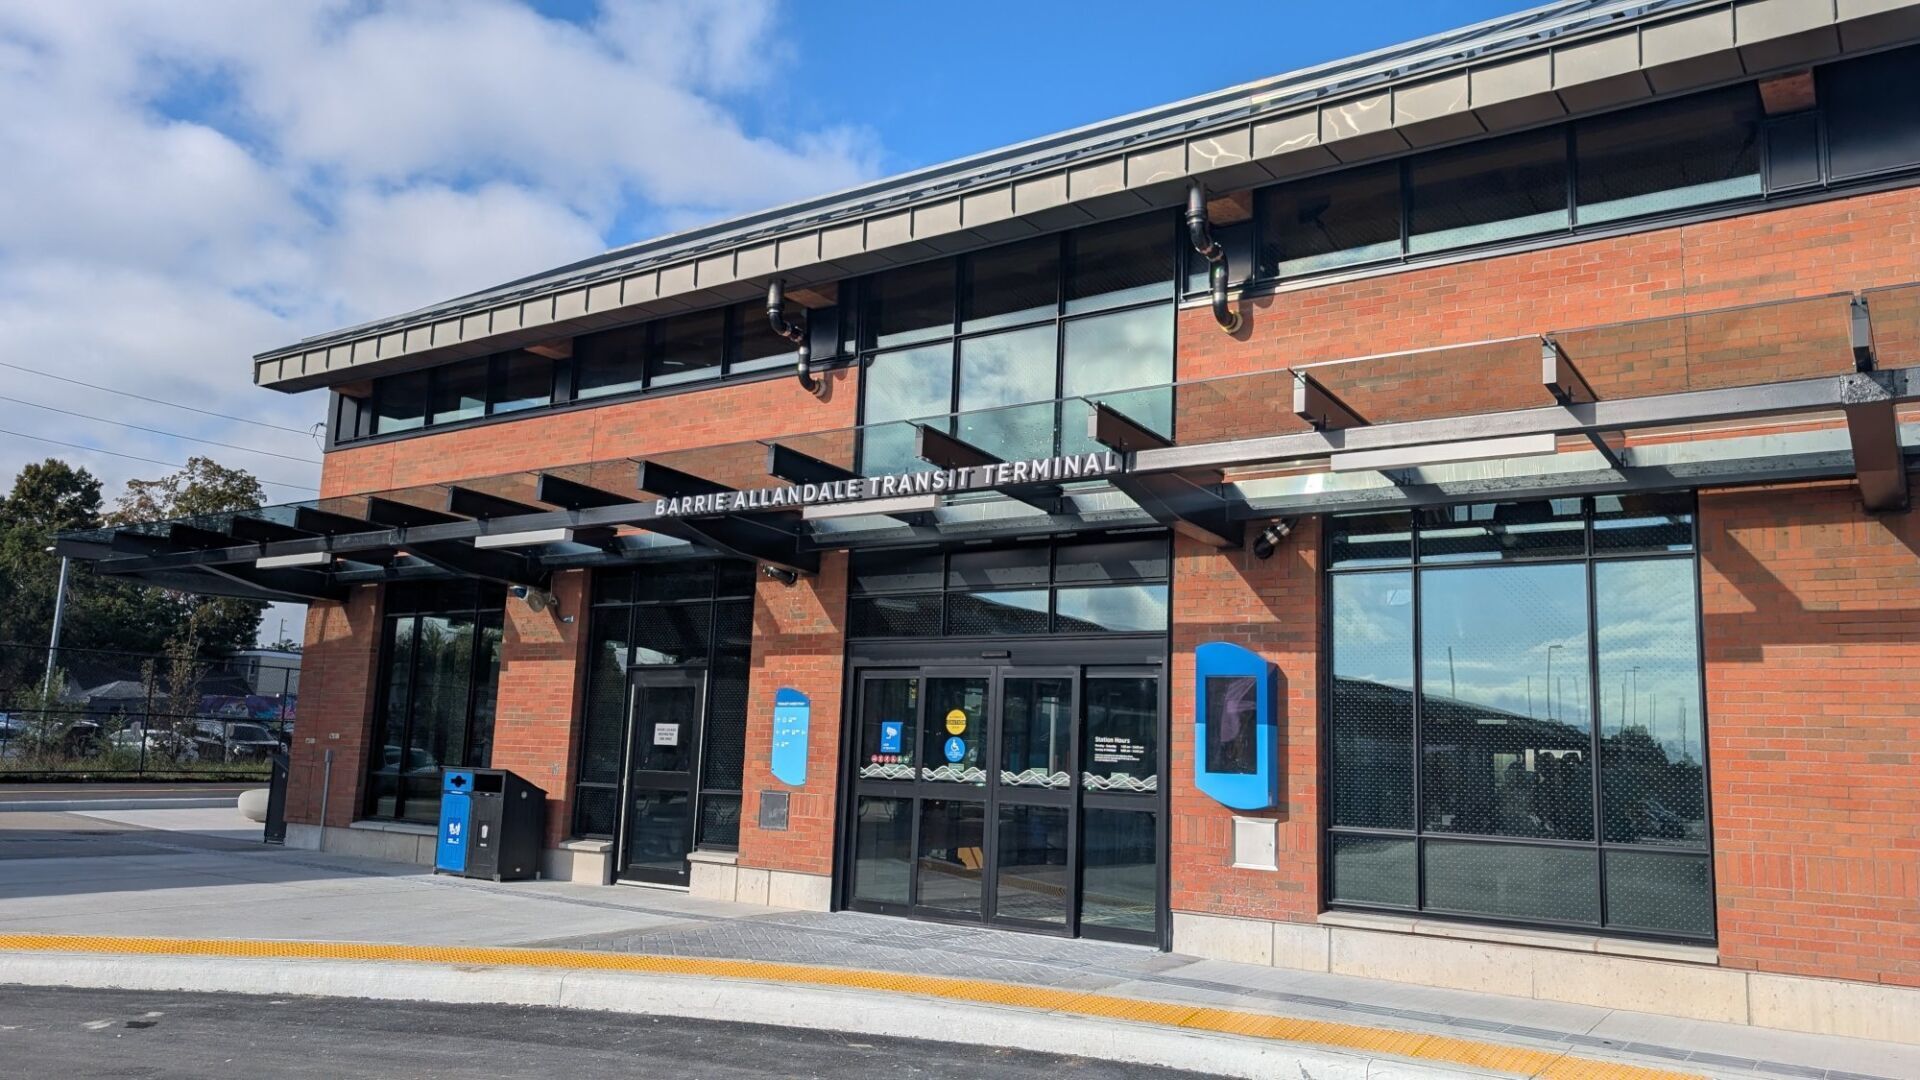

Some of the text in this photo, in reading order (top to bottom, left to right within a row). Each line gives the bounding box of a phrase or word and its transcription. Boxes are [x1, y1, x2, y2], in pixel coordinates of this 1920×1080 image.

[655, 450, 1117, 516] BARRIE ALLANDALE TRANSIT TERMINAL
[1094, 735, 1114, 743] Station
